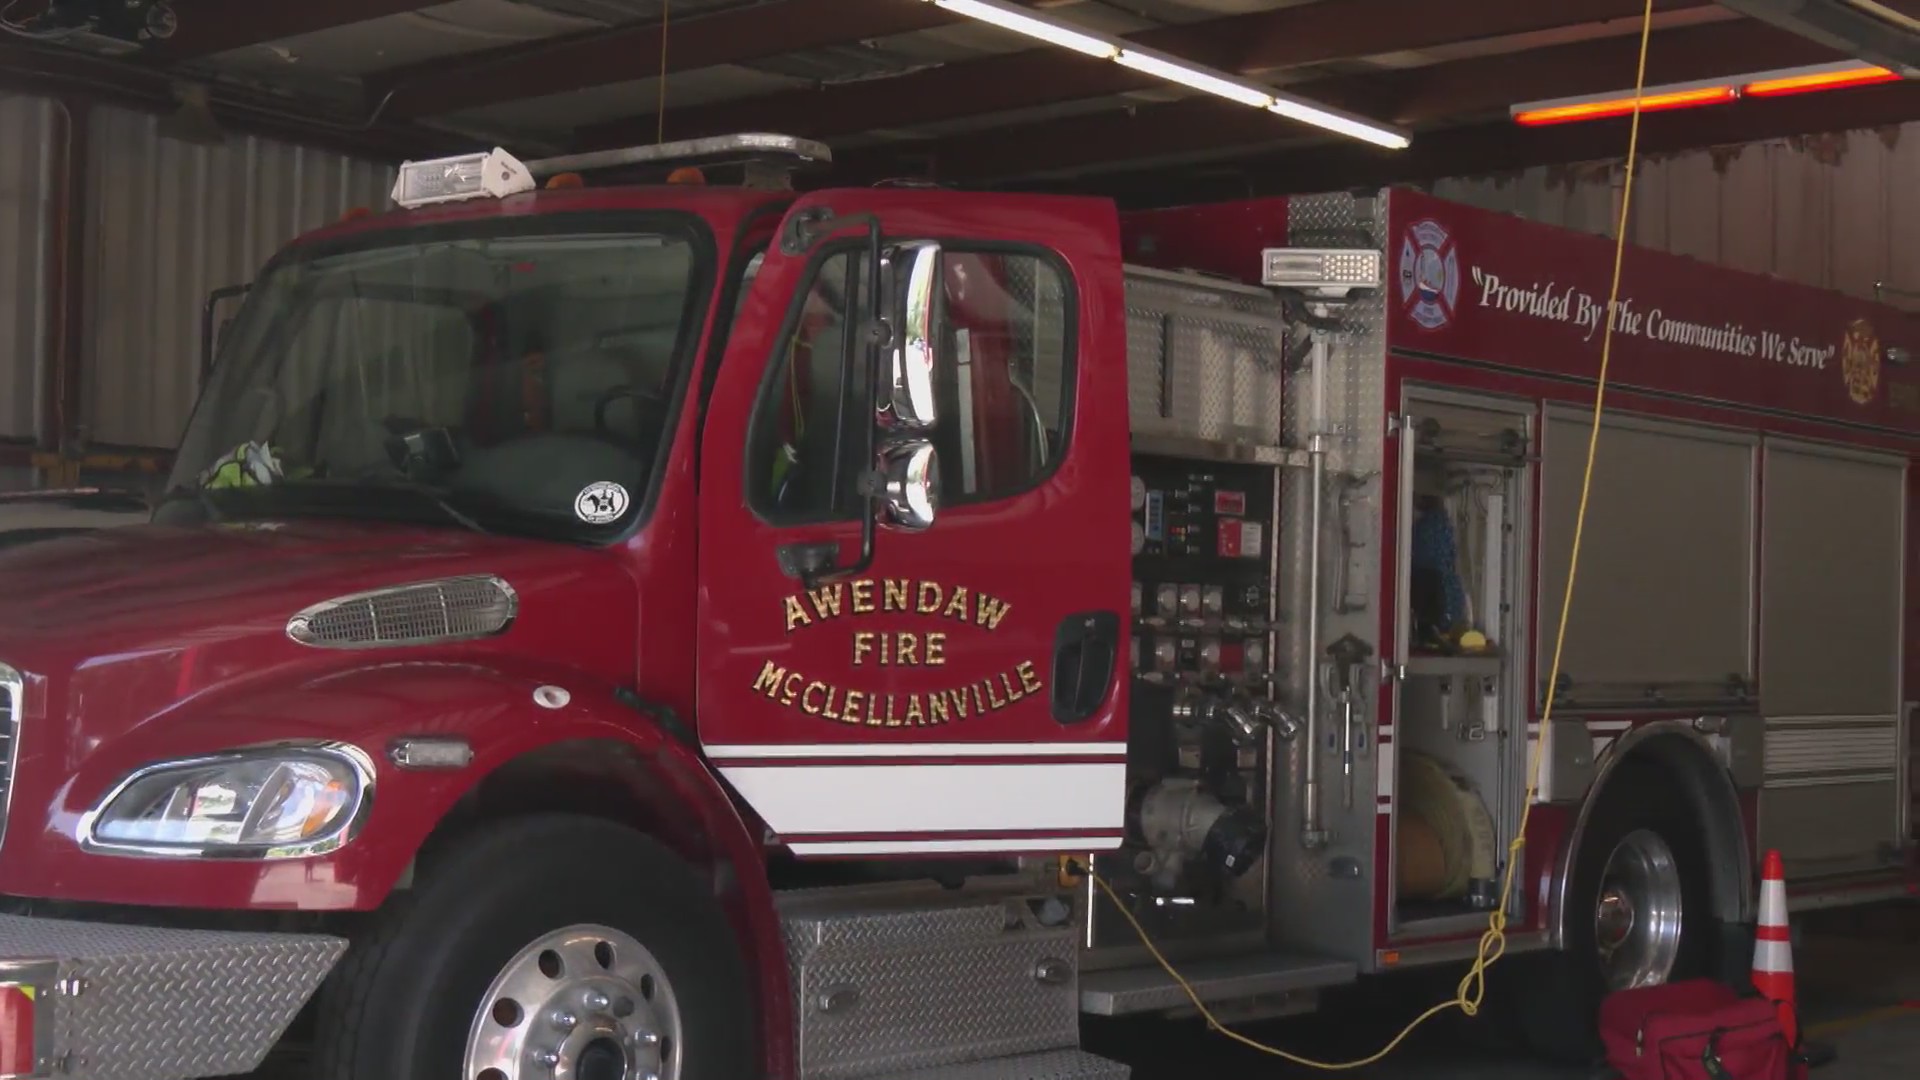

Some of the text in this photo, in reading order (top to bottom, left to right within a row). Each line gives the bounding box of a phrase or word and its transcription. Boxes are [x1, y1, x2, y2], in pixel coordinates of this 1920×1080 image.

[1574, 293, 1602, 341] By
[1606, 299, 1642, 336] The
[1645, 308, 1757, 357] Communities
[1761, 330, 1785, 362] We
[783, 578, 1012, 631] AWENDAW
[853, 632, 947, 664] FIRE
